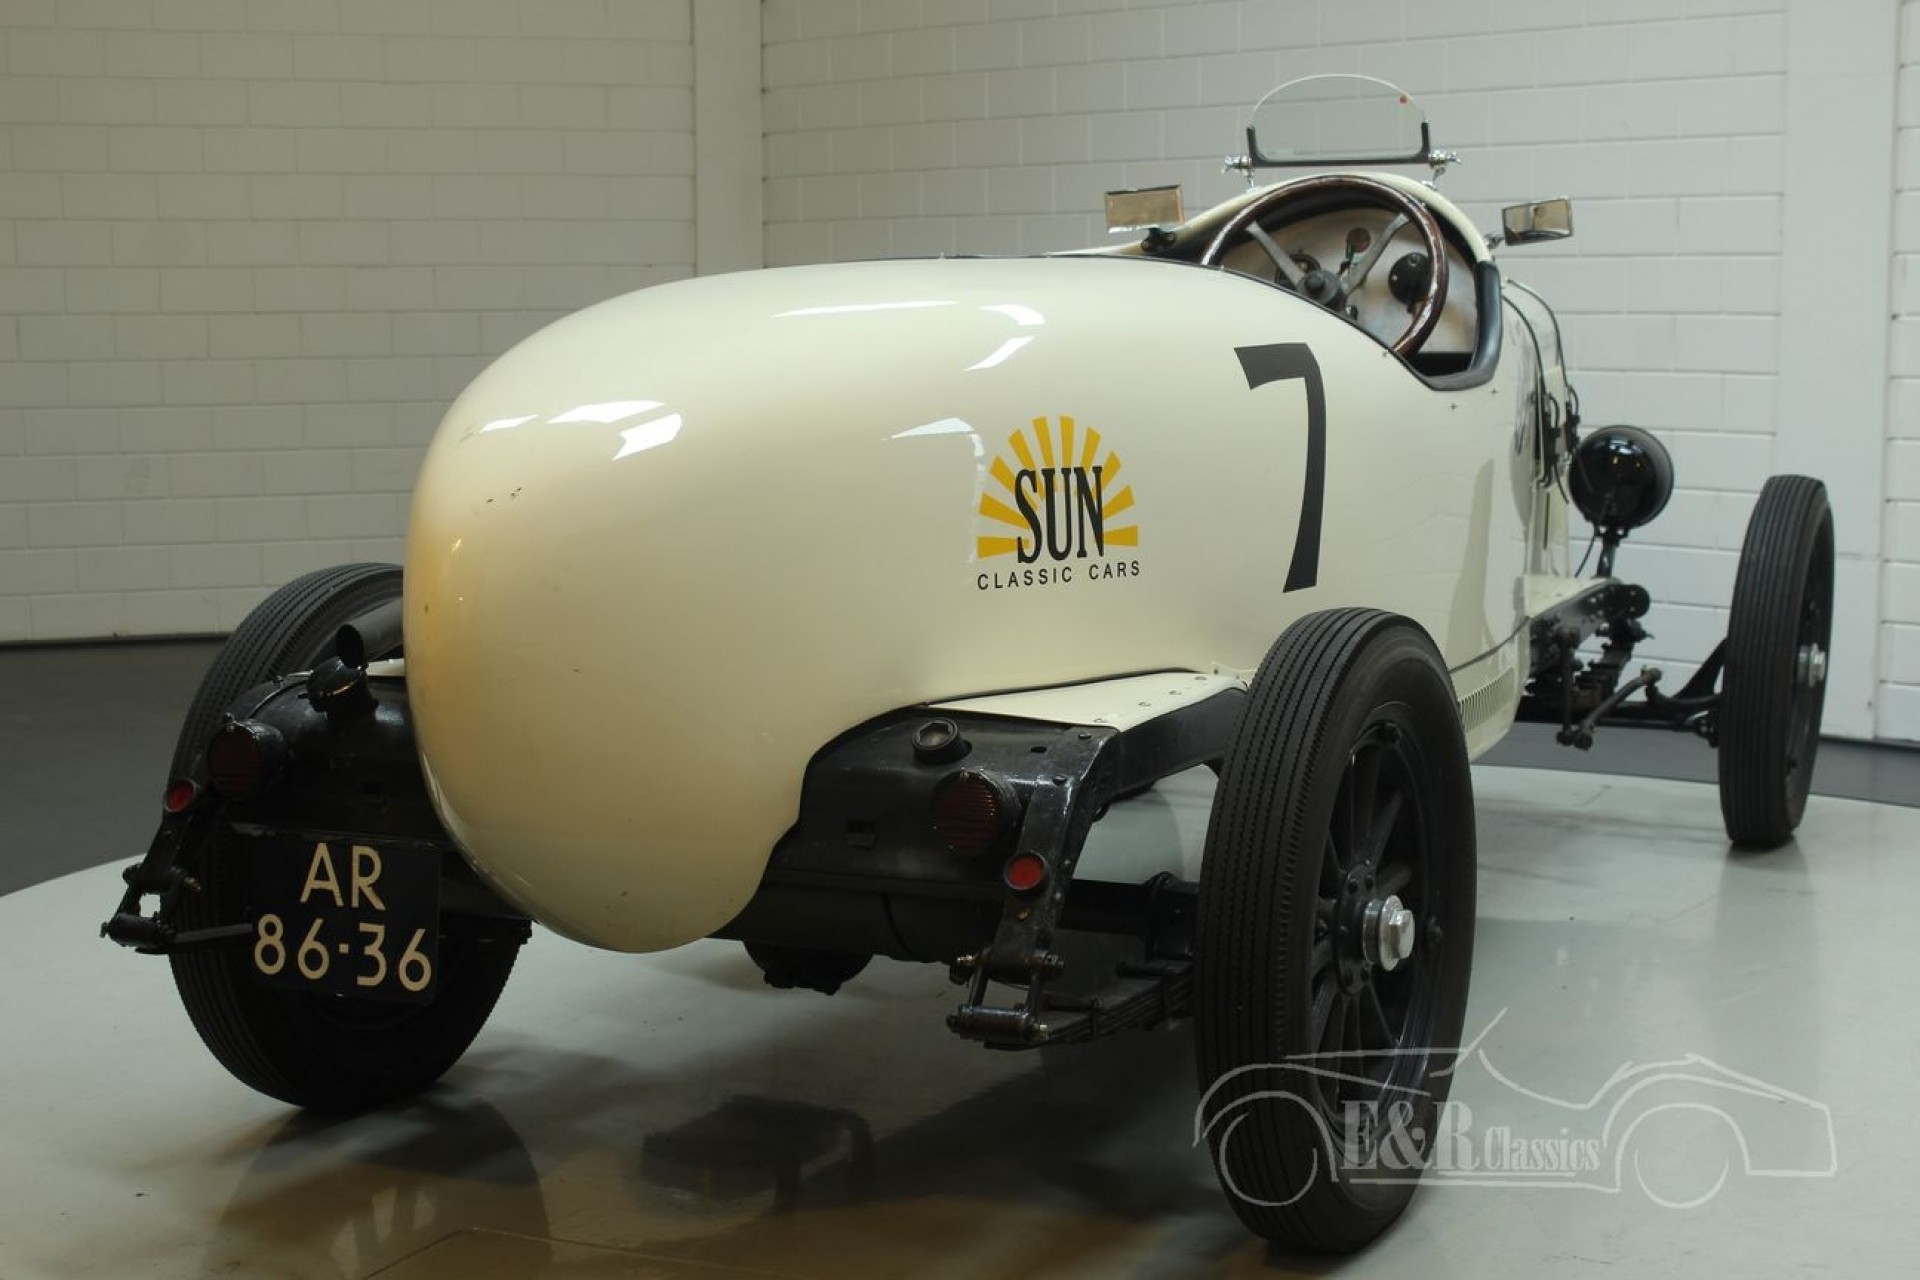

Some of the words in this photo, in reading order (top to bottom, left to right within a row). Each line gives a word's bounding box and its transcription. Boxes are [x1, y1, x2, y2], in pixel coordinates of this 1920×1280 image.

[1233, 342, 1326, 593] 7
[1014, 465, 1104, 563] SUN
[977, 566, 1073, 590] CLASSIC
[1088, 560, 1140, 580] CARS
[300, 842, 386, 911] AR
[254, 913, 432, 992] 86-36
